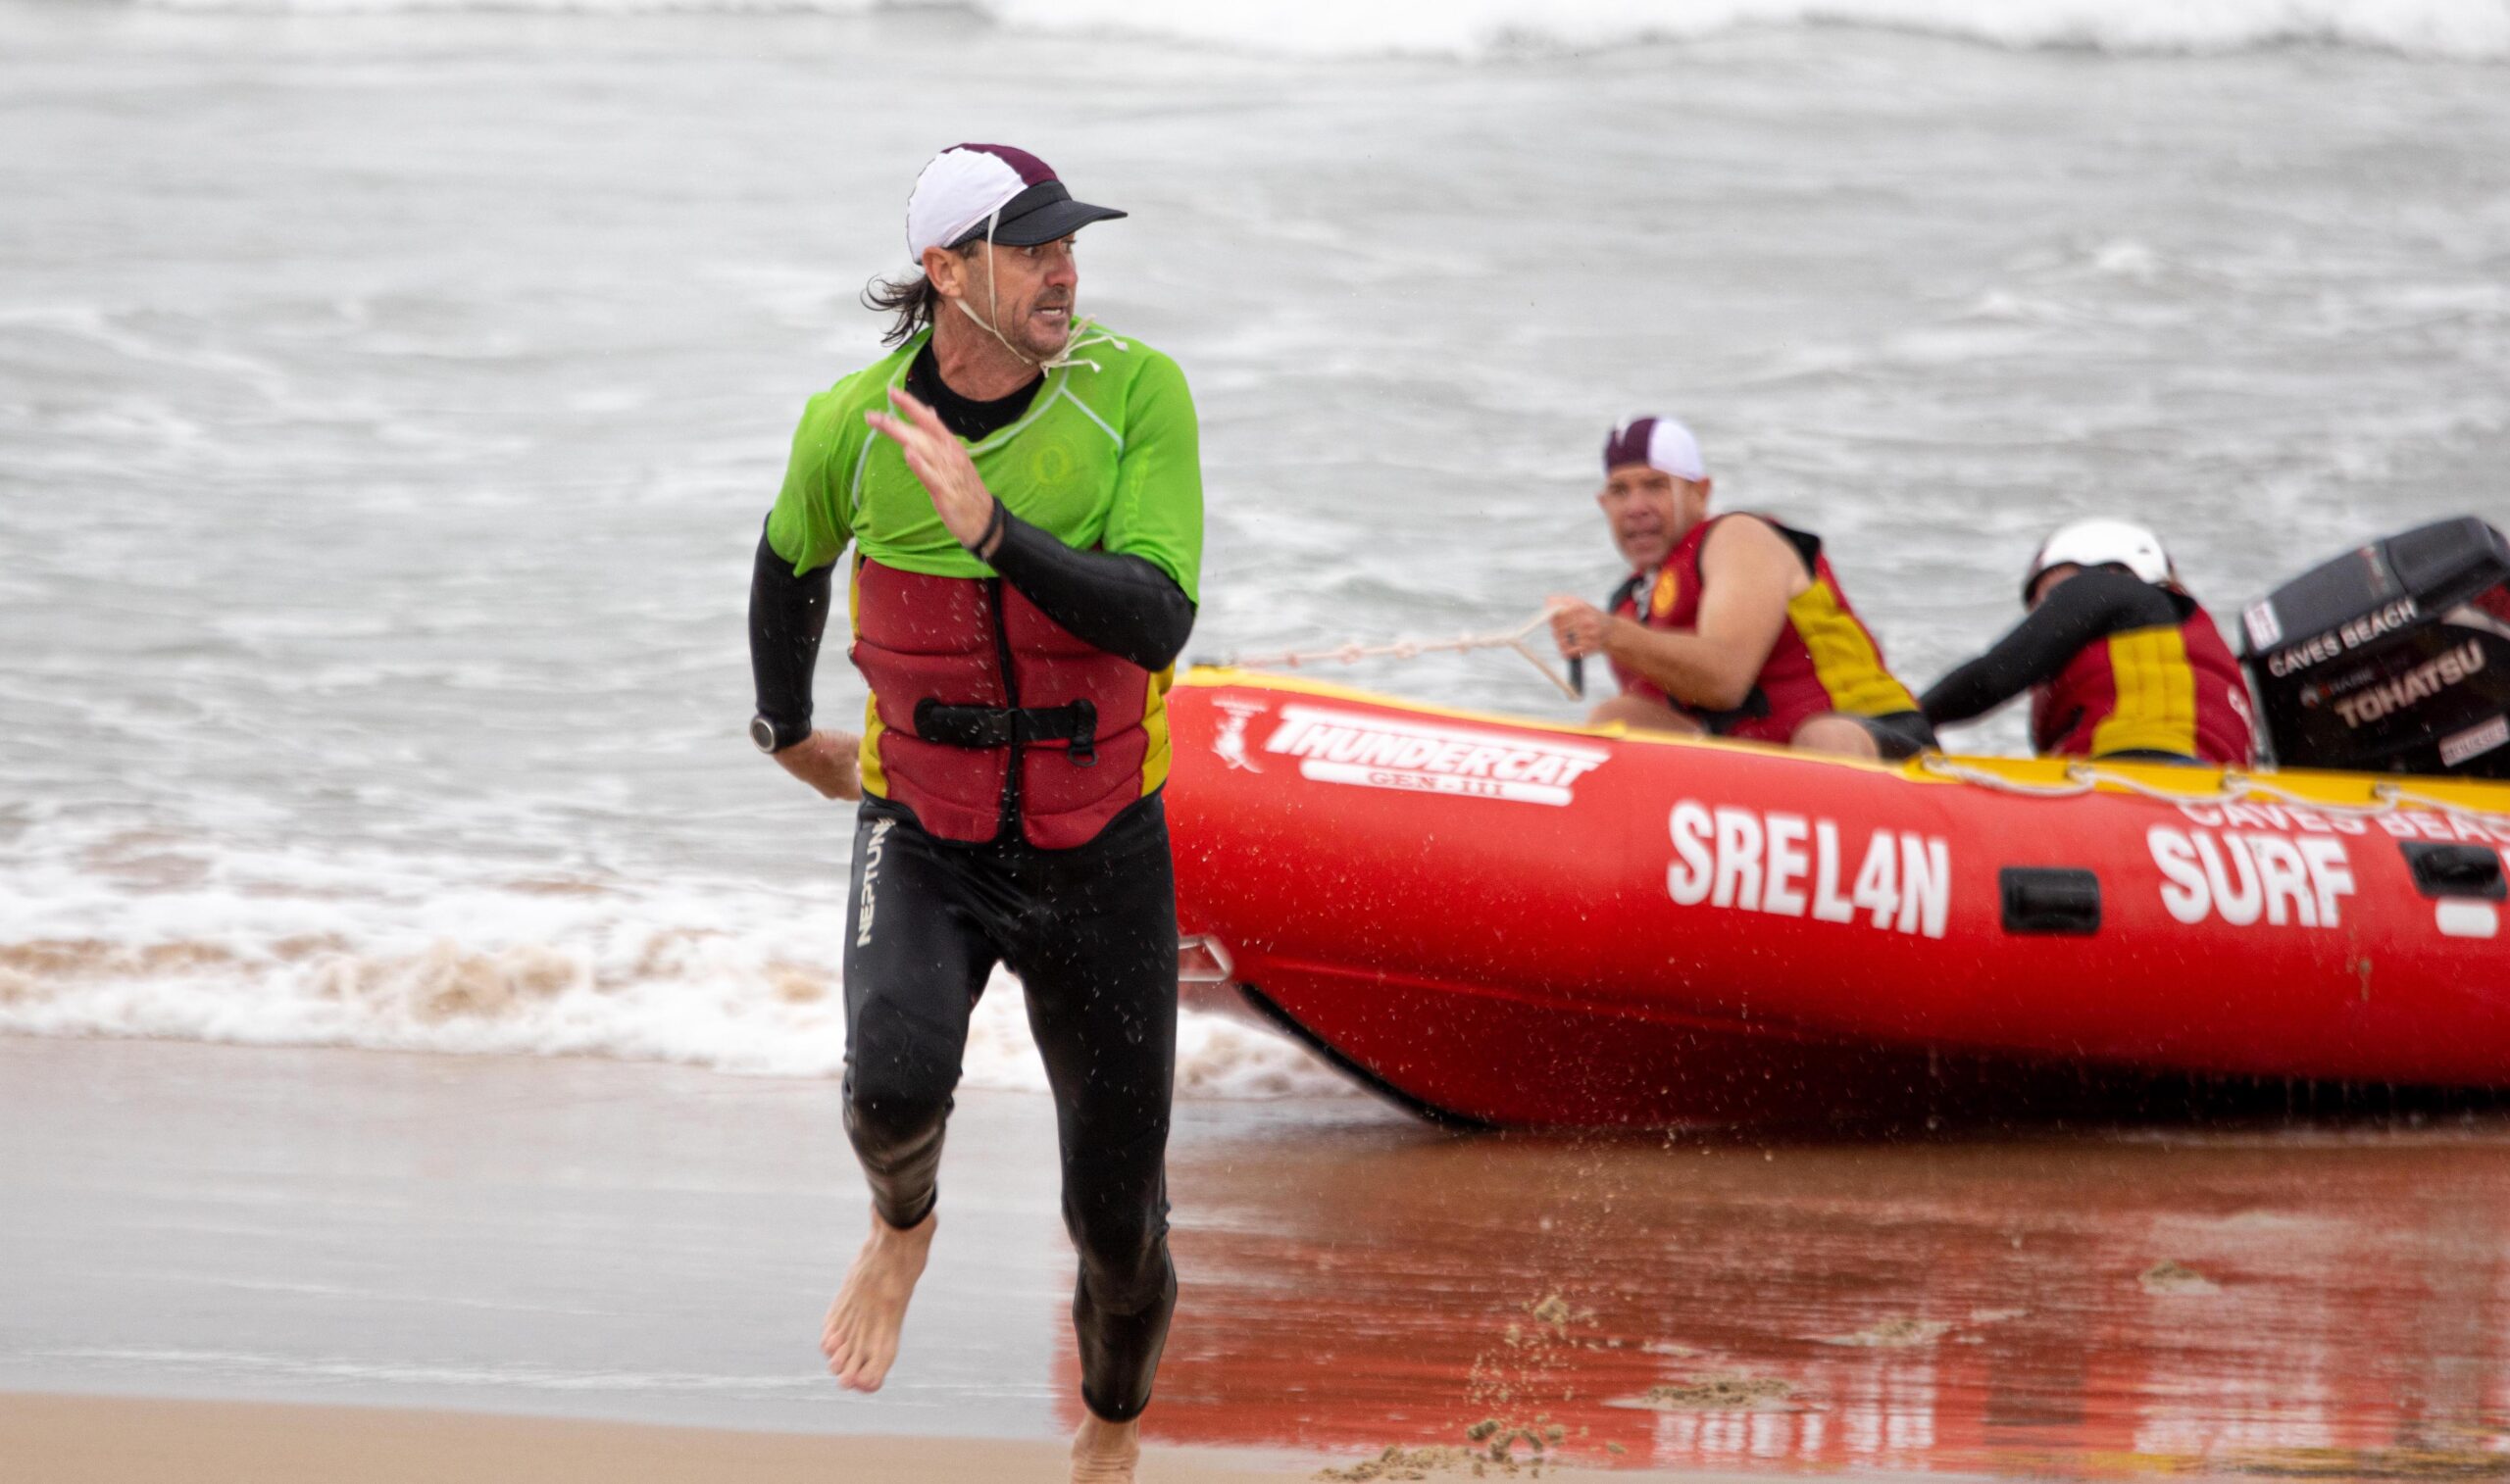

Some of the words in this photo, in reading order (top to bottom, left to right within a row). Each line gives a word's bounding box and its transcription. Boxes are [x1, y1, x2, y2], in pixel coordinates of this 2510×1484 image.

[2269, 631, 2341, 678] CAVES
[2339, 597, 2419, 649] BEACH
[2334, 638, 2485, 729] TOHATSU
[1265, 704, 1610, 787] THUNDERCAT
[2177, 801, 2366, 835] CAVES
[1668, 799, 1951, 939] SREL4N
[2146, 824, 2355, 927] SURF
